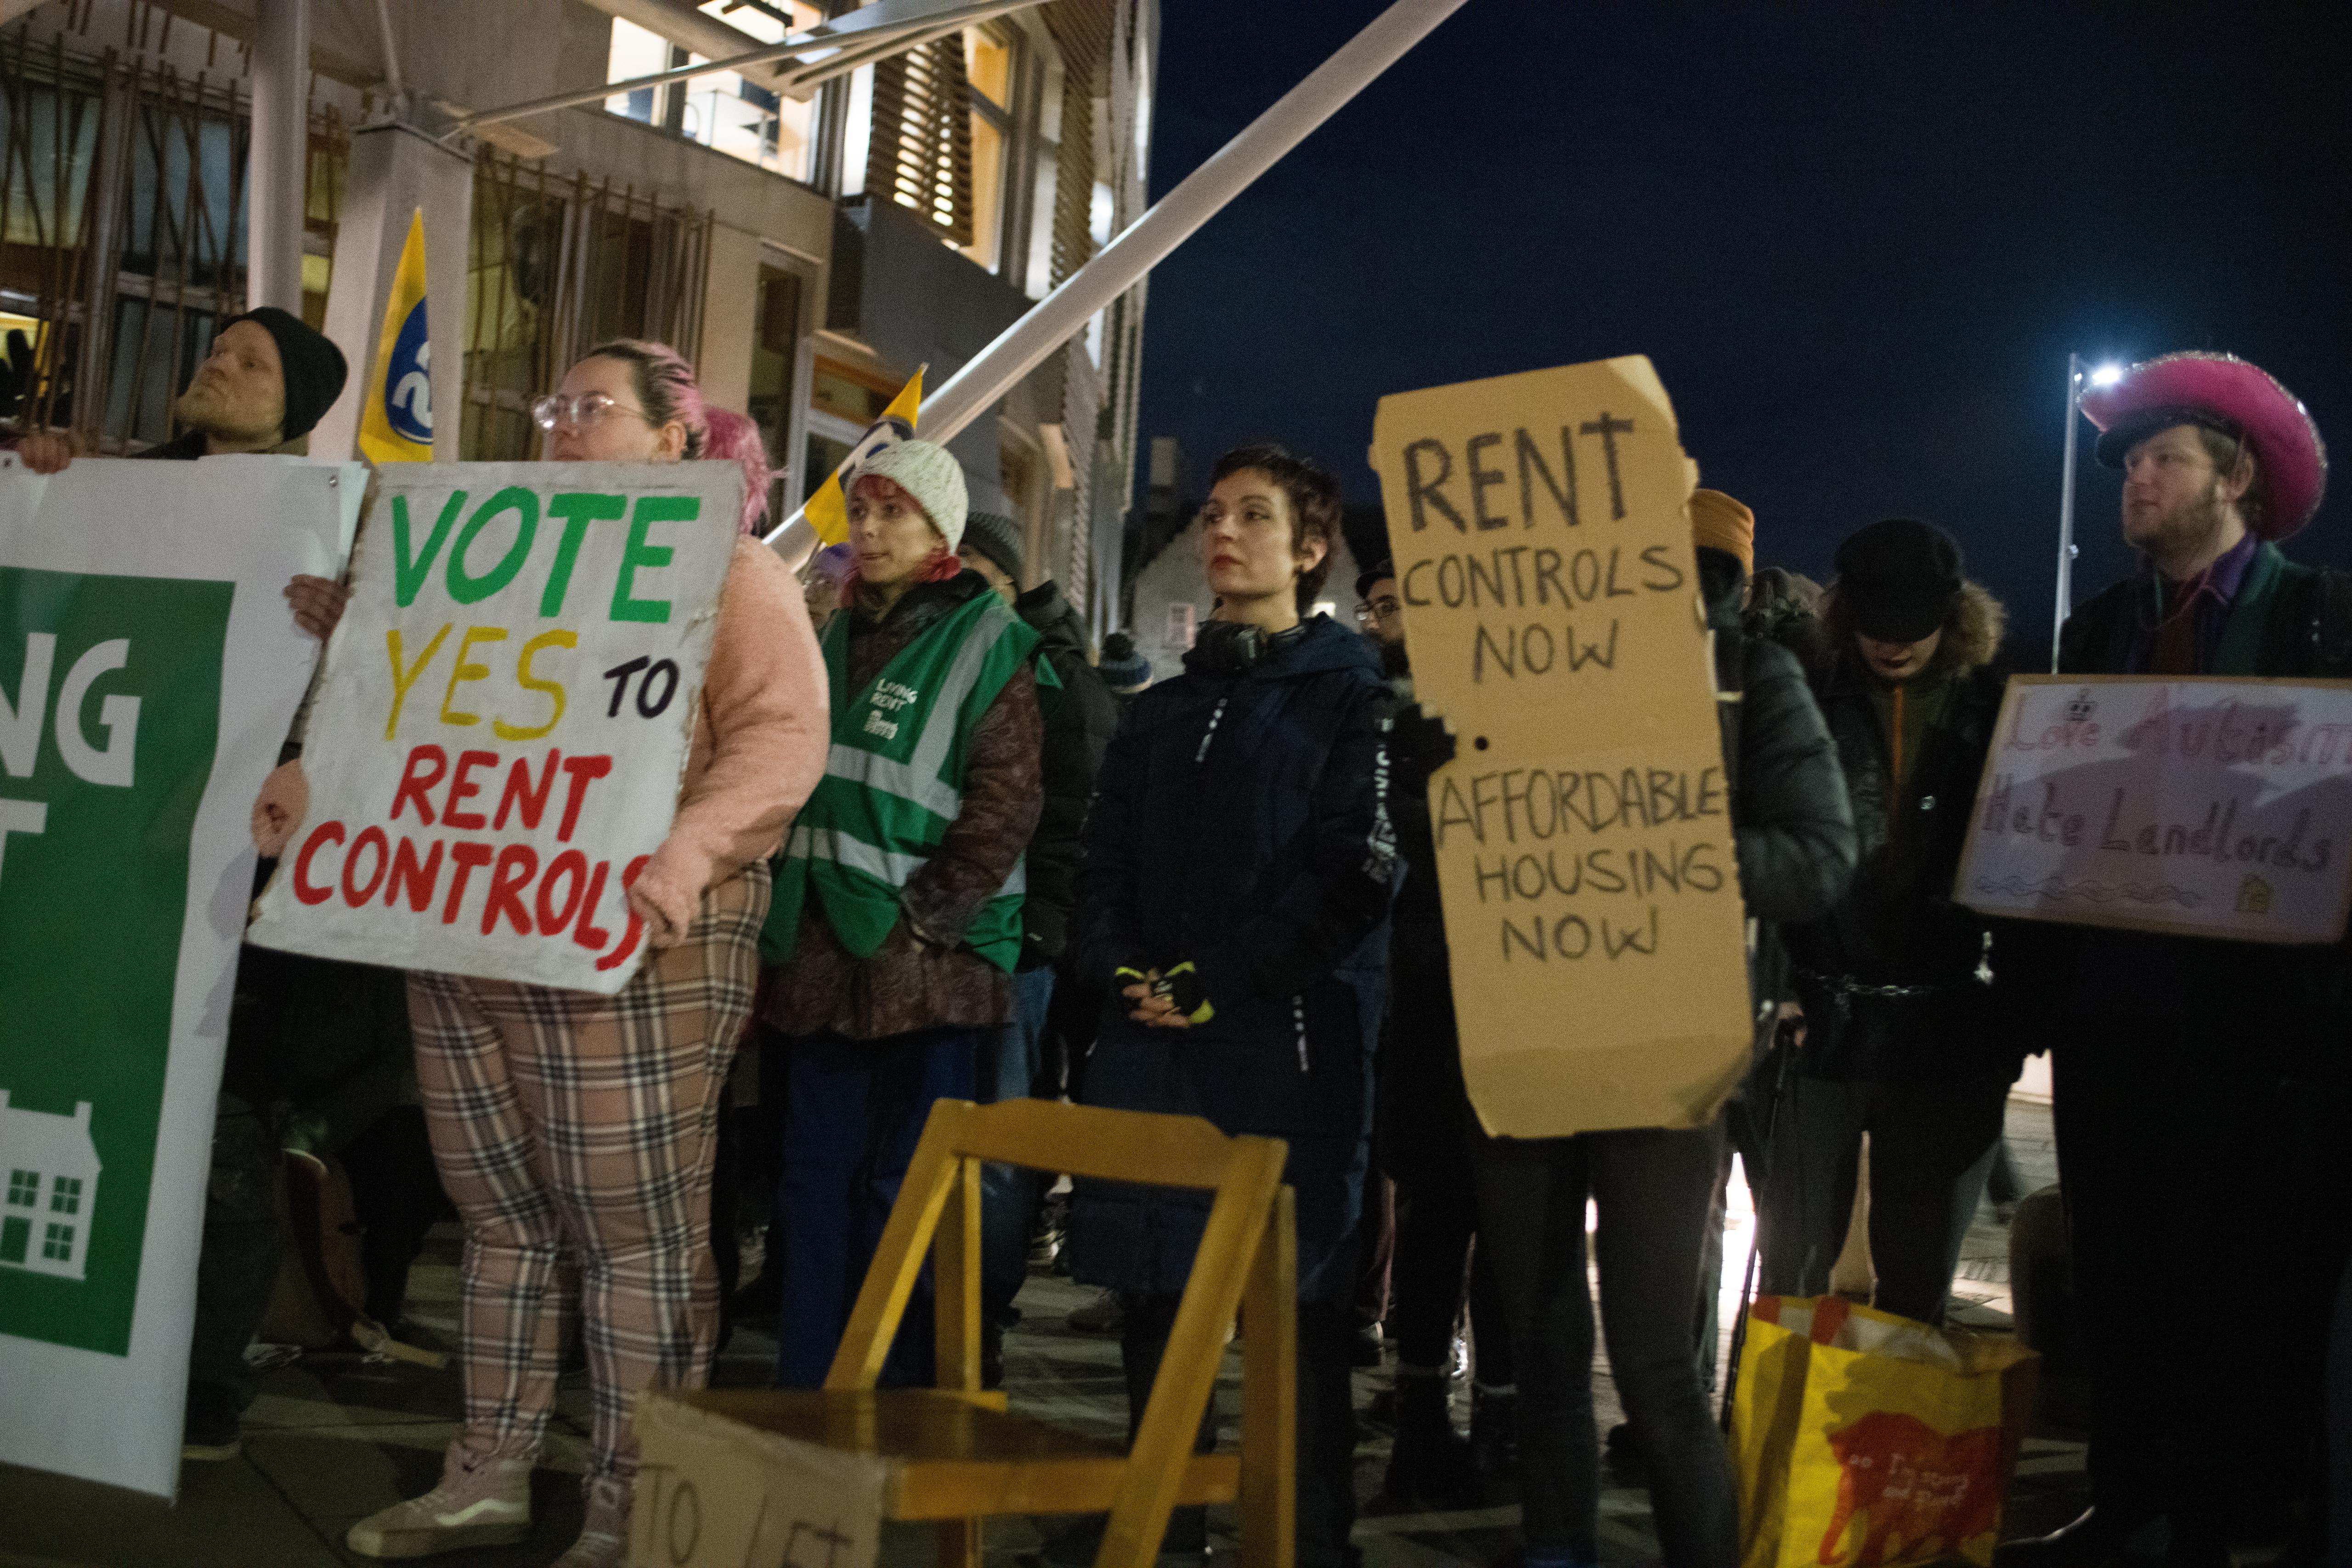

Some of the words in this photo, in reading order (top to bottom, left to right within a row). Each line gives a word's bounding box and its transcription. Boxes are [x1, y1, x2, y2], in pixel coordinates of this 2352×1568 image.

[1402, 411, 1634, 534] RENT
[391, 485, 701, 624] VOTE
[1402, 546, 1684, 609] CONTROLS
[385, 622, 578, 741] YES
[603, 655, 680, 719] TO
[1473, 618, 1619, 684] NOW
[390, 744, 612, 843] RENT
[1435, 766, 1723, 850] AFFORDABLE
[1982, 772, 2084, 846] Hate
[2098, 786, 2335, 872] Landlords
[293, 820, 652, 971] CONTROLS
[1475, 840, 1724, 903] HOUSING
[1502, 903, 1658, 963] NOW
[638, 1462, 702, 1566] TO
